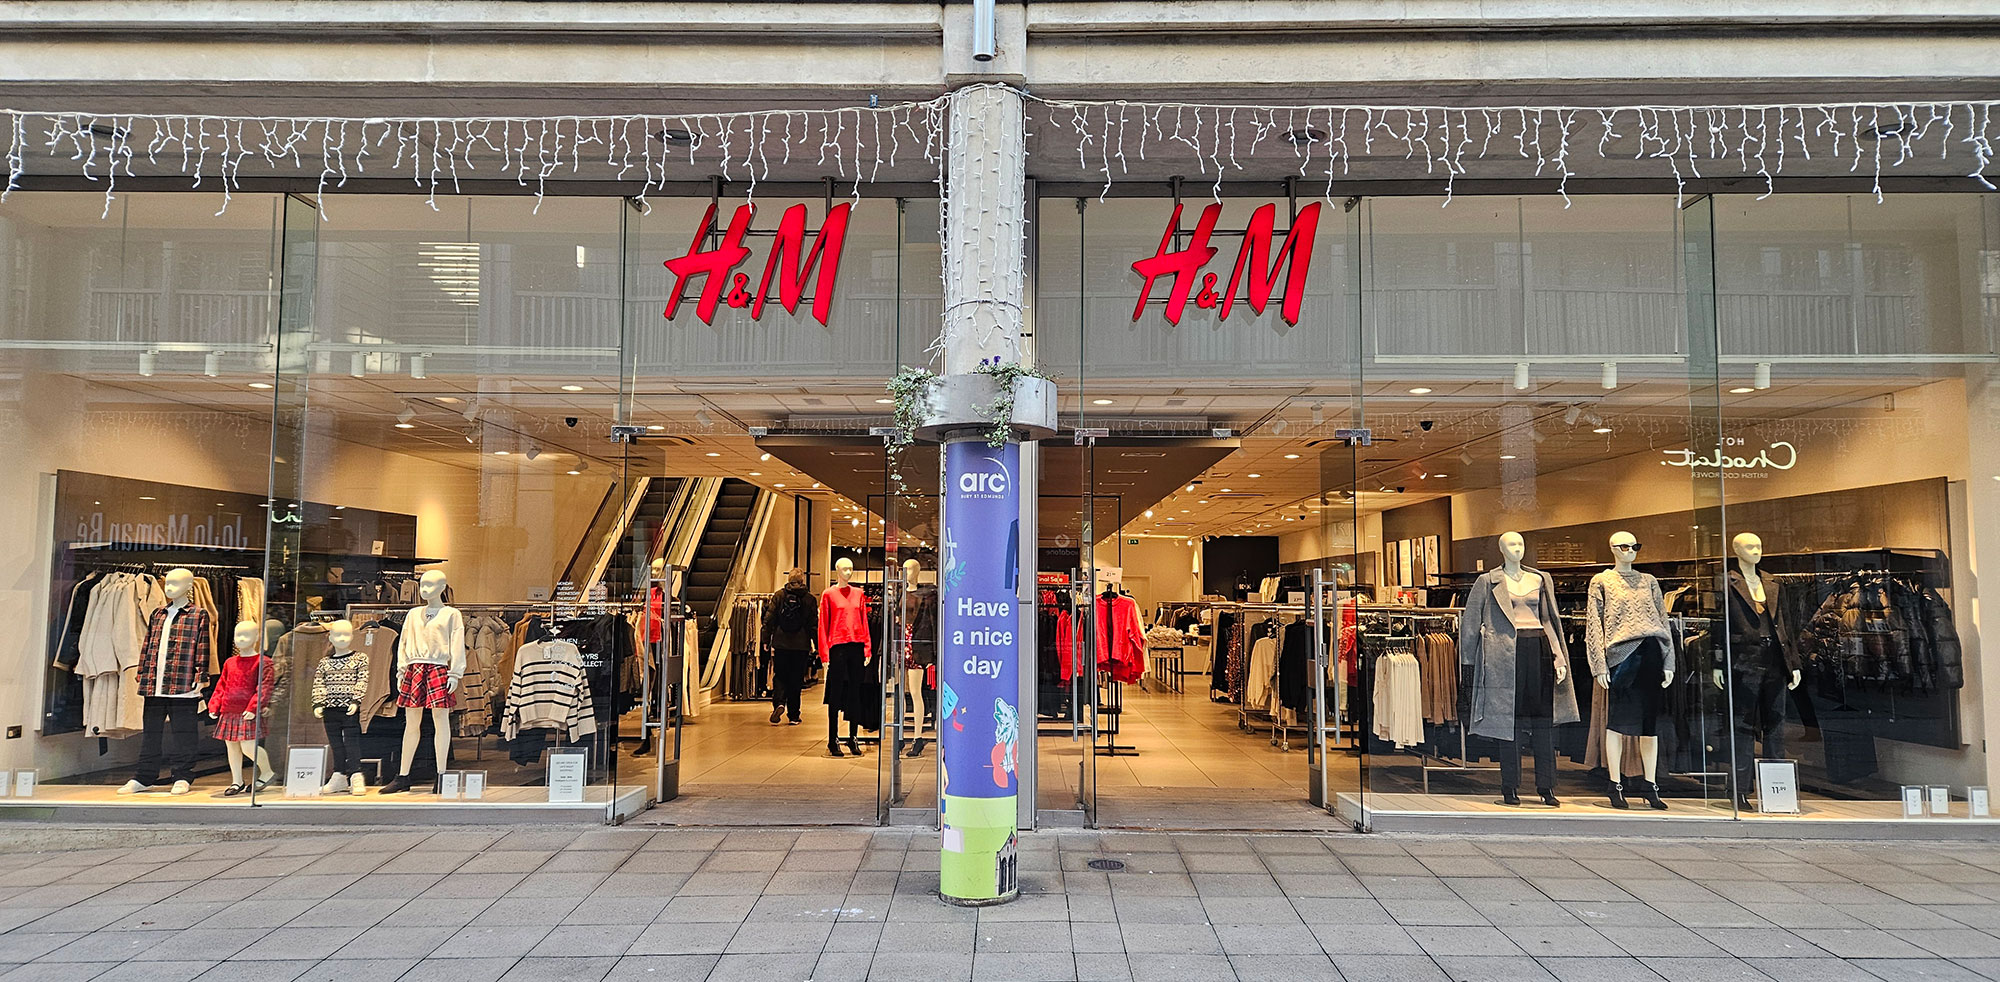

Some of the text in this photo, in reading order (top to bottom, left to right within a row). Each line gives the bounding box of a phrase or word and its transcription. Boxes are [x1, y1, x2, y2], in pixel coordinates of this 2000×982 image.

[663, 202, 852, 327] H&M
[1131, 202, 1321, 328] H&M
[959, 472, 1006, 493] arc
[957, 597, 1010, 617] Have
[952, 626, 1013, 646] a nice
[963, 655, 1003, 679] day
